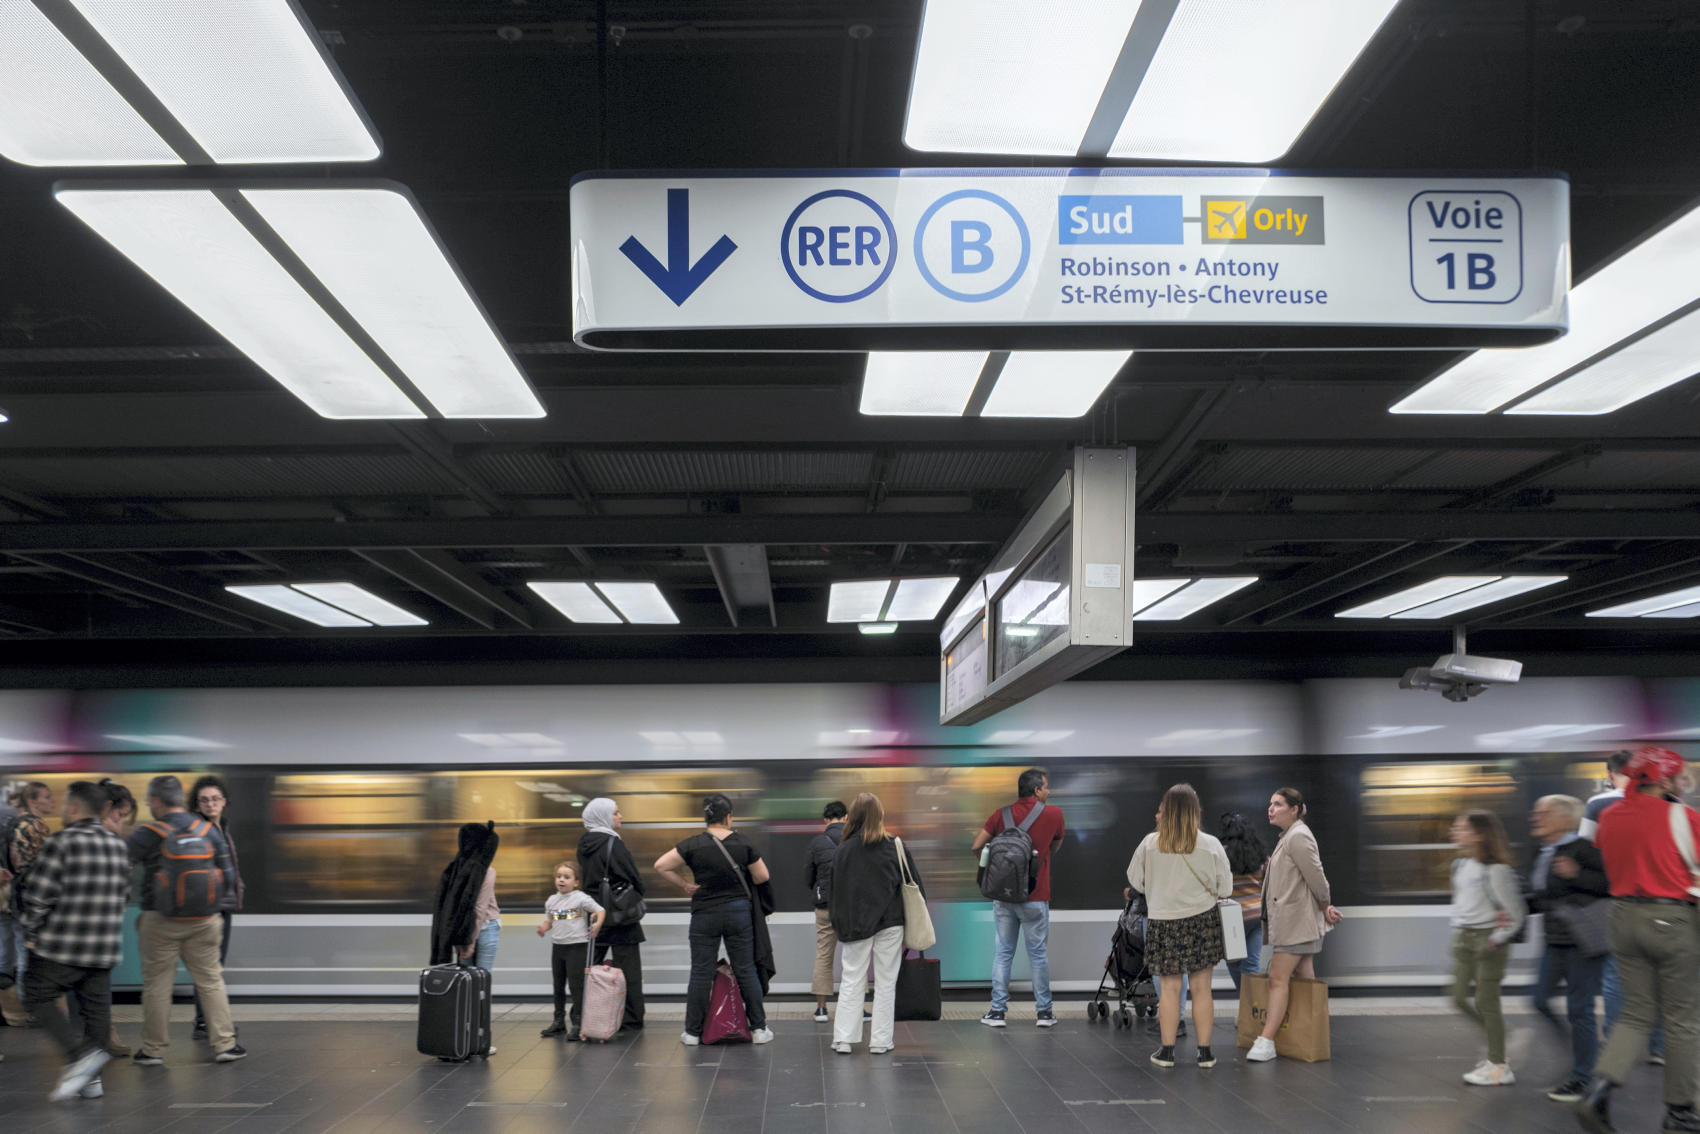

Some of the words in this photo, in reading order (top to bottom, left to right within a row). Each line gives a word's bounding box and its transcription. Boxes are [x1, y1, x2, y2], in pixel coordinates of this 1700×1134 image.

[1070, 205, 1133, 234] Sud
[1253, 208, 1308, 236] Orly
[1427, 200, 1504, 230] Voie
[798, 226, 882, 266] RER
[951, 220, 994, 274] B
[1061, 257, 1171, 277] Robinson
[1195, 258, 1280, 281] Antony
[1436, 253, 1497, 290] 1B
[1061, 285, 1328, 308] St-Rémy-lès-Chevreuse
